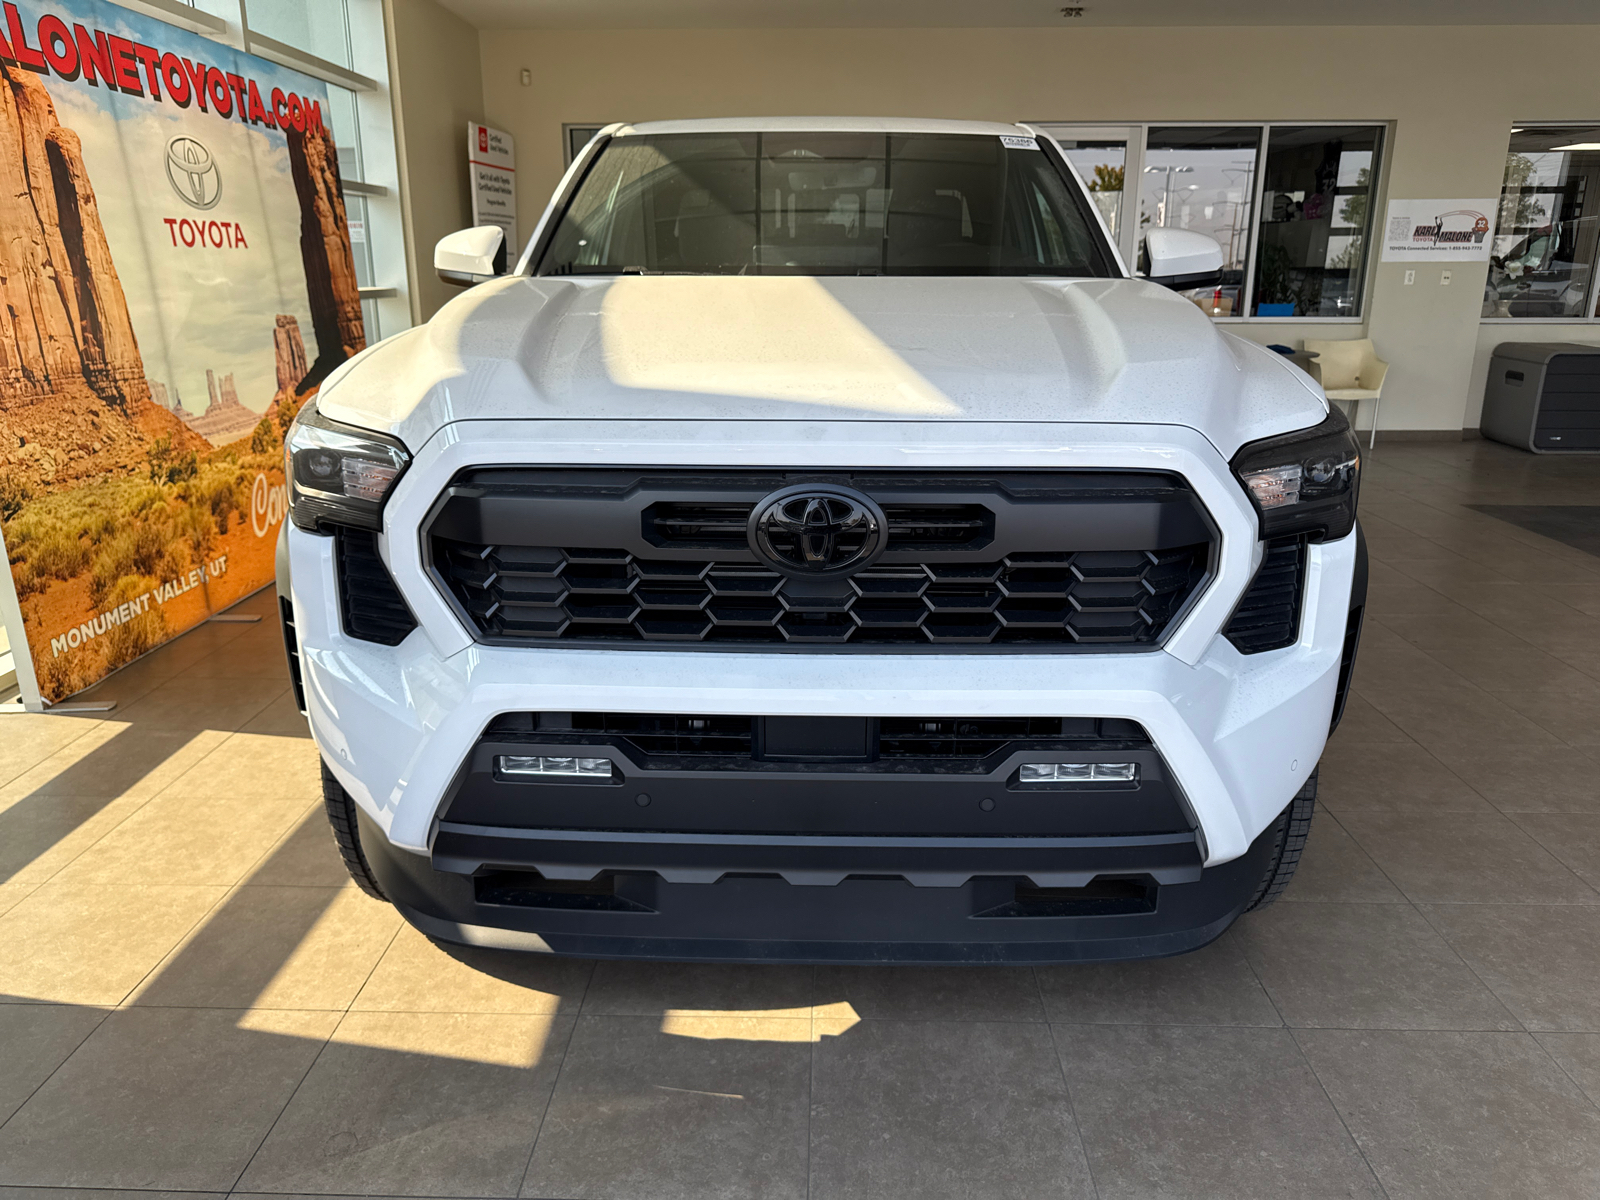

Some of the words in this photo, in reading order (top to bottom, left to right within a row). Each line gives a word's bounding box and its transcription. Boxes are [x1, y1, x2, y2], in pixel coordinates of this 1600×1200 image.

[163, 217, 249, 249] TOYOTA
[1413, 225, 1437, 236] KARL
[1438, 231, 1474, 243] MALONE
[1477, 220, 1486, 228] 32
[51, 593, 150, 658] MONUMENT
[153, 565, 210, 605] VALLEY,
[209, 555, 227, 577] UT
